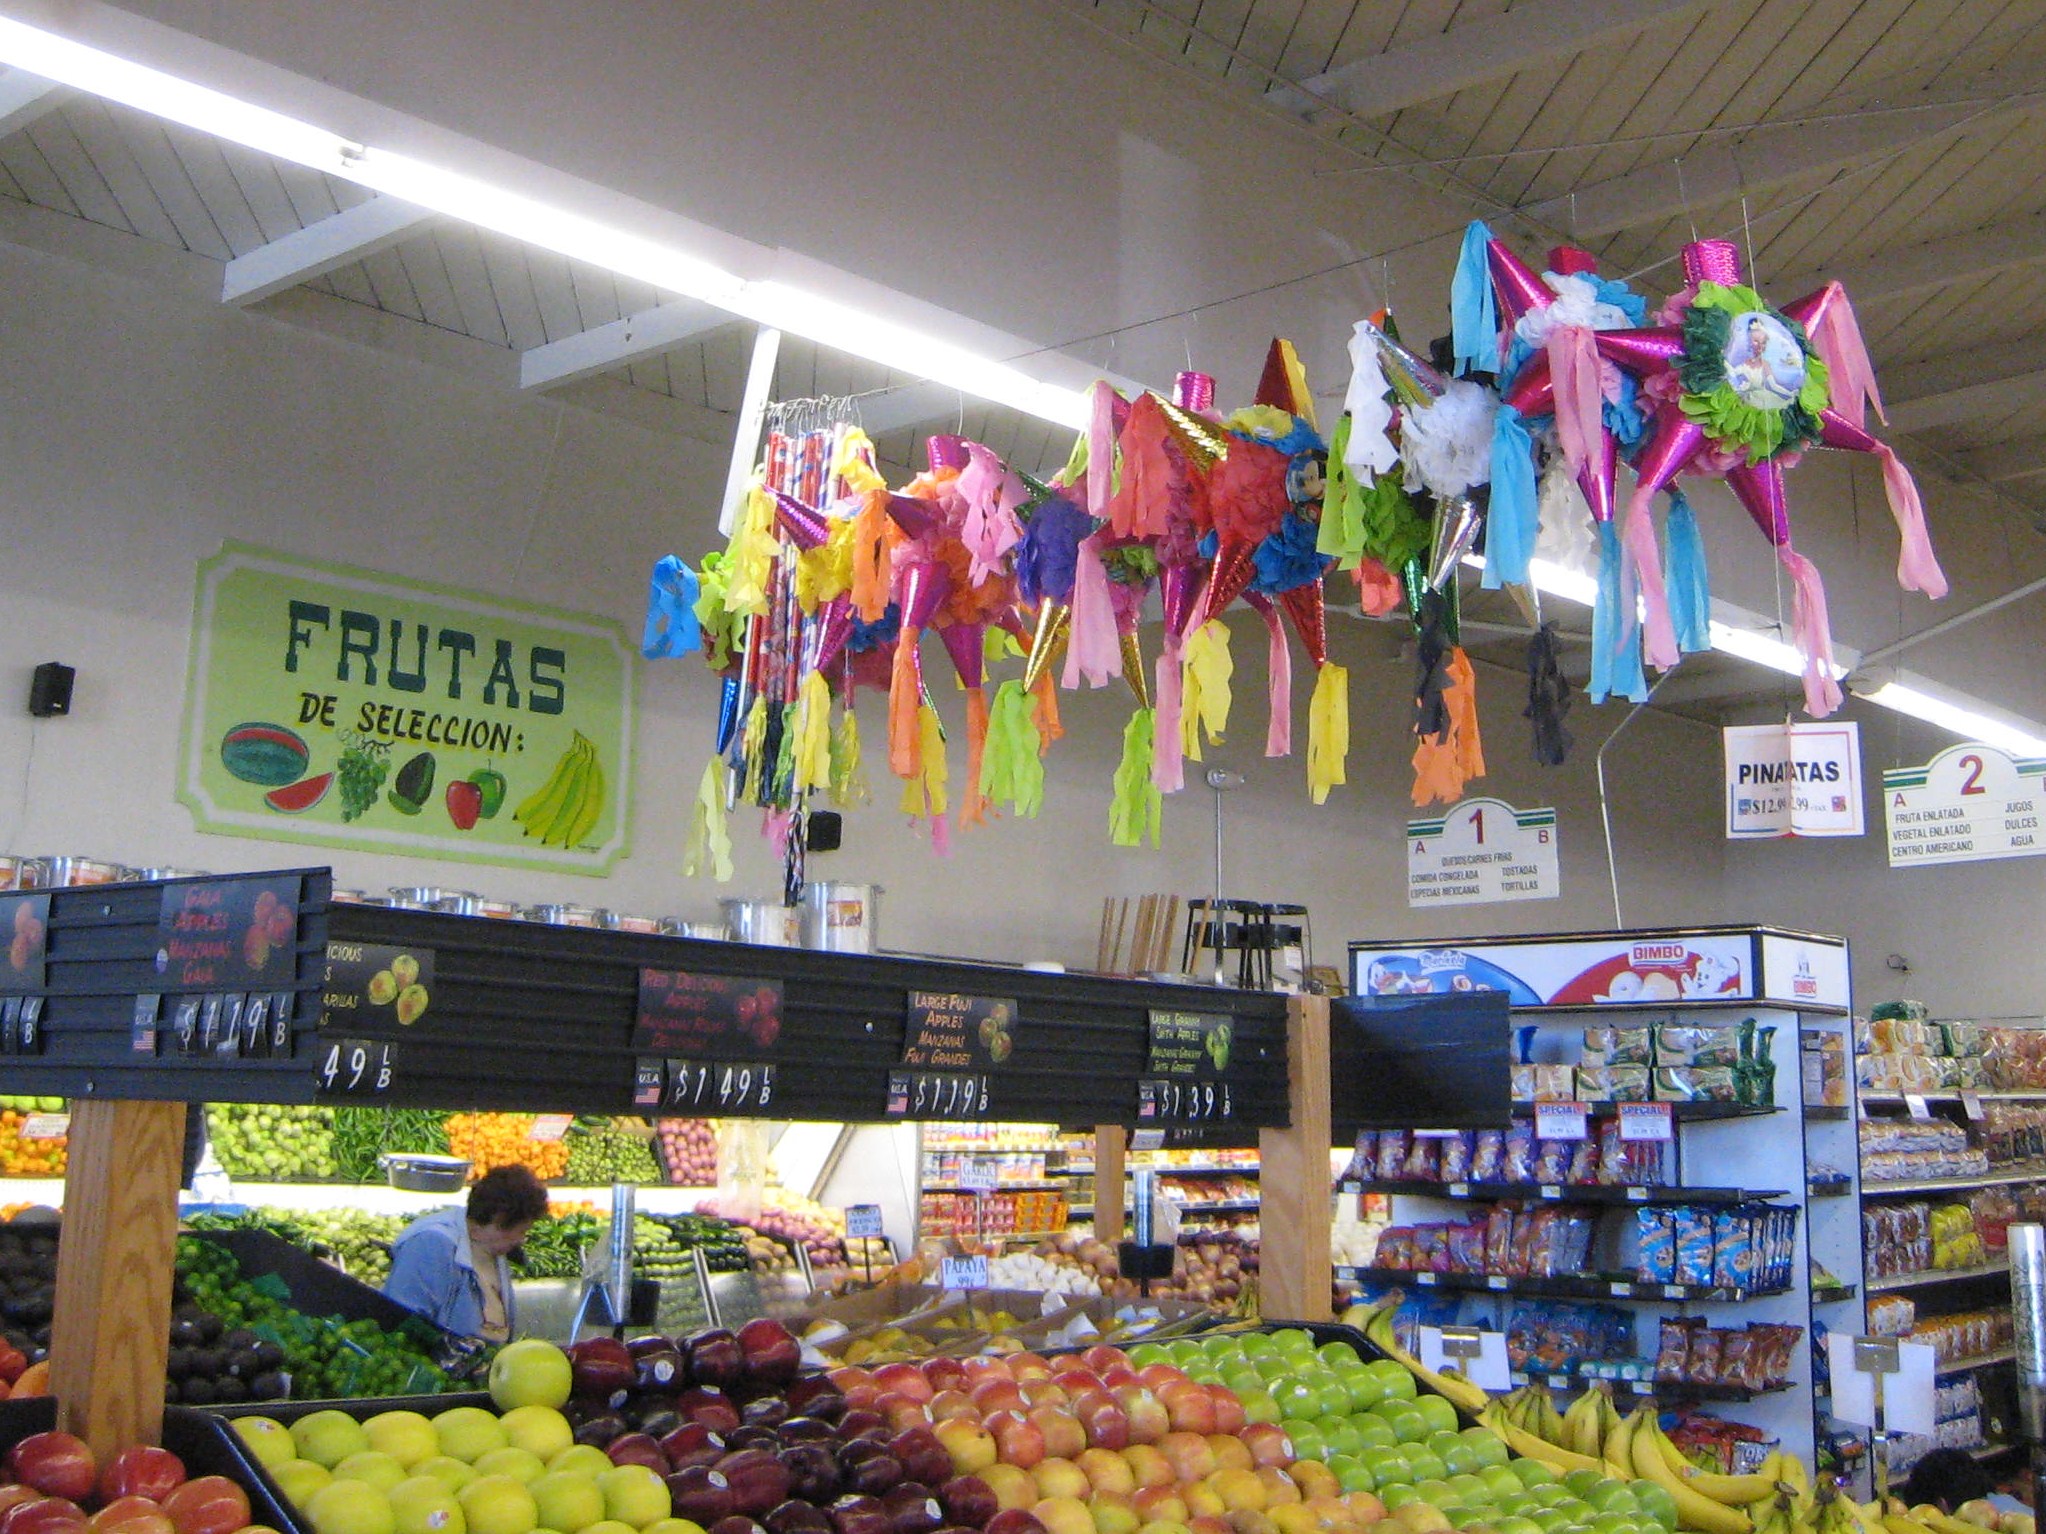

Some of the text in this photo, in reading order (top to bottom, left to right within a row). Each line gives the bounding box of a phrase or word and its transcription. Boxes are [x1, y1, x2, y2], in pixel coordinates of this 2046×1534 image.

[285, 600, 566, 715] FRUTAS
[299, 692, 338, 727] DE
[1958, 754, 1986, 796] 2
[1893, 792, 1907, 807] A
[2005, 800, 2034, 813] JUGOS
[1895, 807, 1965, 824] FRUTA ENLATADA
[1468, 807, 1484, 845] 1
[2004, 817, 2038, 830] DULCES
[1538, 829, 1549, 844] B
[1892, 823, 1972, 841] VEGETAL ENLATADO
[1415, 840, 1426, 854] A
[2010, 834, 2035, 847] AGUA
[1891, 840, 1974, 858] CENTRO AMERICANO
[1502, 864, 1538, 876] TOSTADAS
[1442, 884, 1480, 897] MEXICANAS
[1501, 880, 1539, 892] TORTILLAS
[1633, 945, 1684, 960] BIMBO
[1793, 979, 1817, 994] BIMBO
[914, 992, 973, 1012] LARGE FUJI
[925, 1010, 965, 1029] APPLES
[638, 1072, 660, 1084] USA
